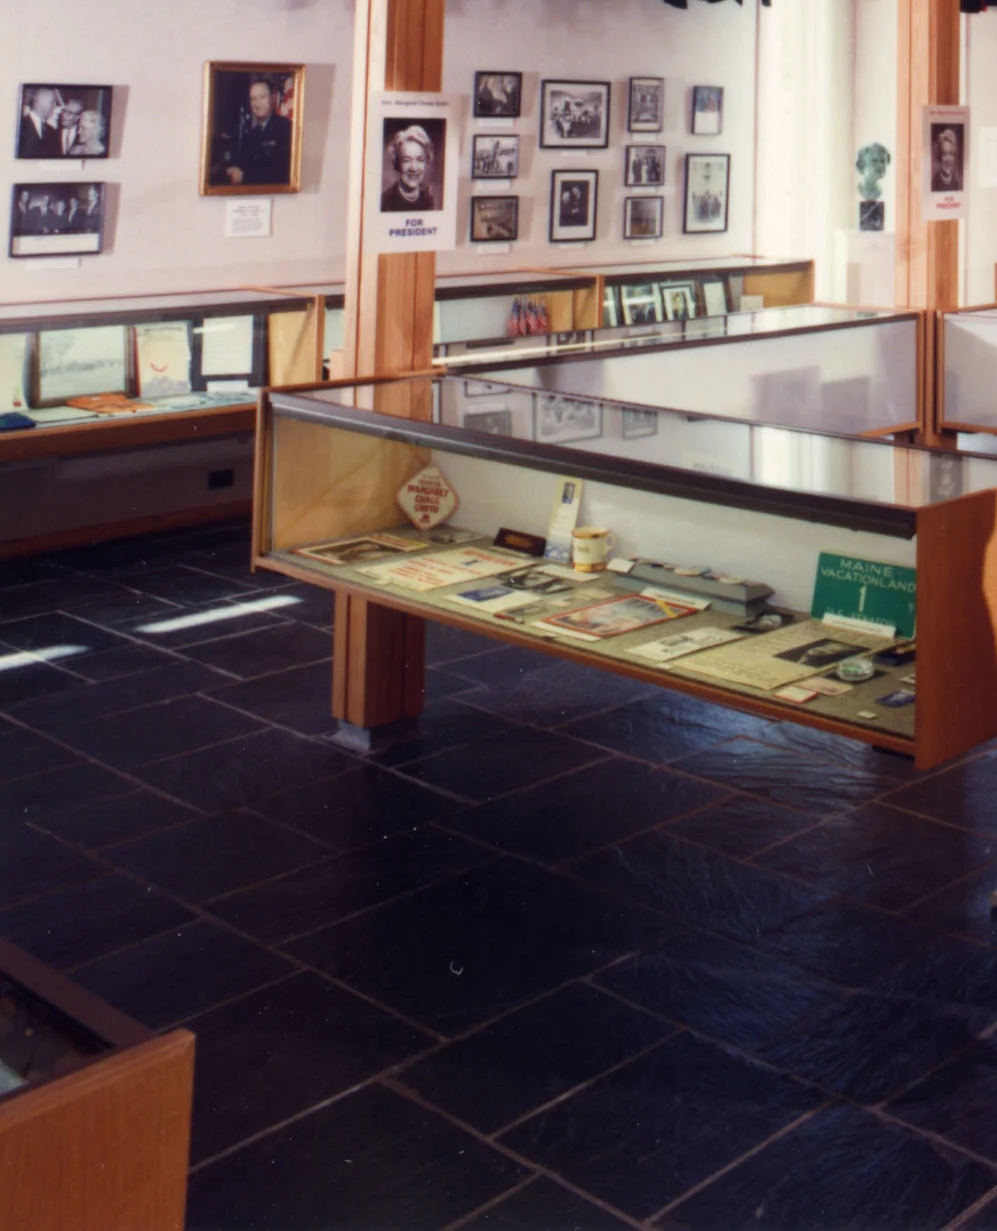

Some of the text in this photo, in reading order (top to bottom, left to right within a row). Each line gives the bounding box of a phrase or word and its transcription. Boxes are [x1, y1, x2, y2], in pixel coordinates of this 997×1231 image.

[405, 219, 423, 227] FOR
[389, 227, 437, 237] PRESIDENT
[407, 484, 449, 497] MARGARET
[840, 559, 895, 578] MAINE
[821, 566, 916, 593] VACATIONLAND
[859, 584, 868, 613] 1
